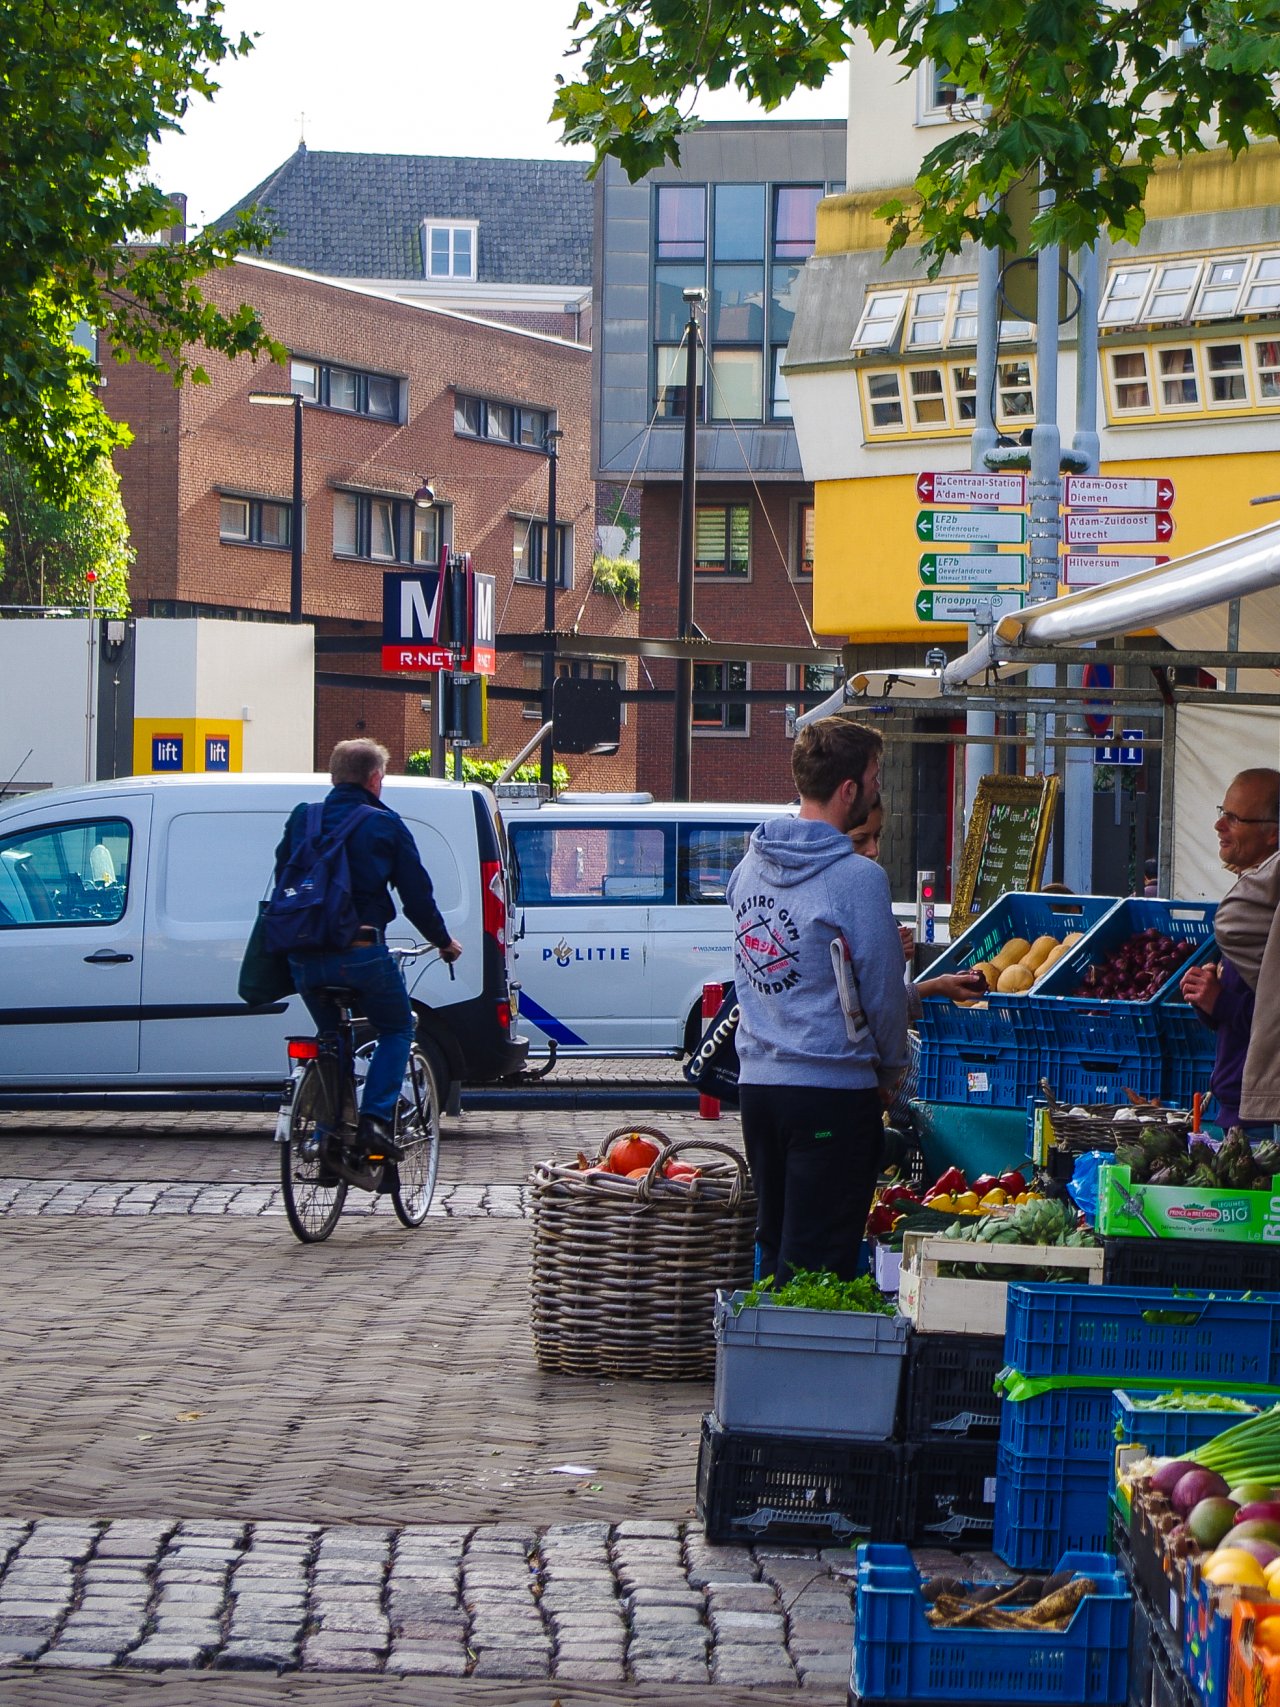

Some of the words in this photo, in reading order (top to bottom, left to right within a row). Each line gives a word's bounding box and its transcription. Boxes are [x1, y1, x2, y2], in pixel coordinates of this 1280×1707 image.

[947, 477, 1021, 488] Centraal-Station
[1070, 480, 1128, 490] A'dam-Oost
[935, 490, 1000, 500] A'dam-Noord
[1070, 493, 1108, 503] Diemen
[935, 515, 958, 524] LF2b
[1069, 516, 1148, 526] A'dam-Zuidoost
[935, 525, 980, 533] Stedenroute
[1070, 531, 1108, 540] Utrecht
[938, 558, 959, 567] LF7b
[1069, 558, 1120, 568] Hilversum
[938, 568, 992, 576] Oeverlandroute
[477, 582, 492, 641] M
[158, 742, 177, 761] lift
[210, 743, 226, 762] lift
[736, 895, 775, 923] MEJIRO
[778, 909, 800, 941] GYM
[543, 947, 630, 967] POLITIE
[1222, 1206, 1249, 1222] BIO
